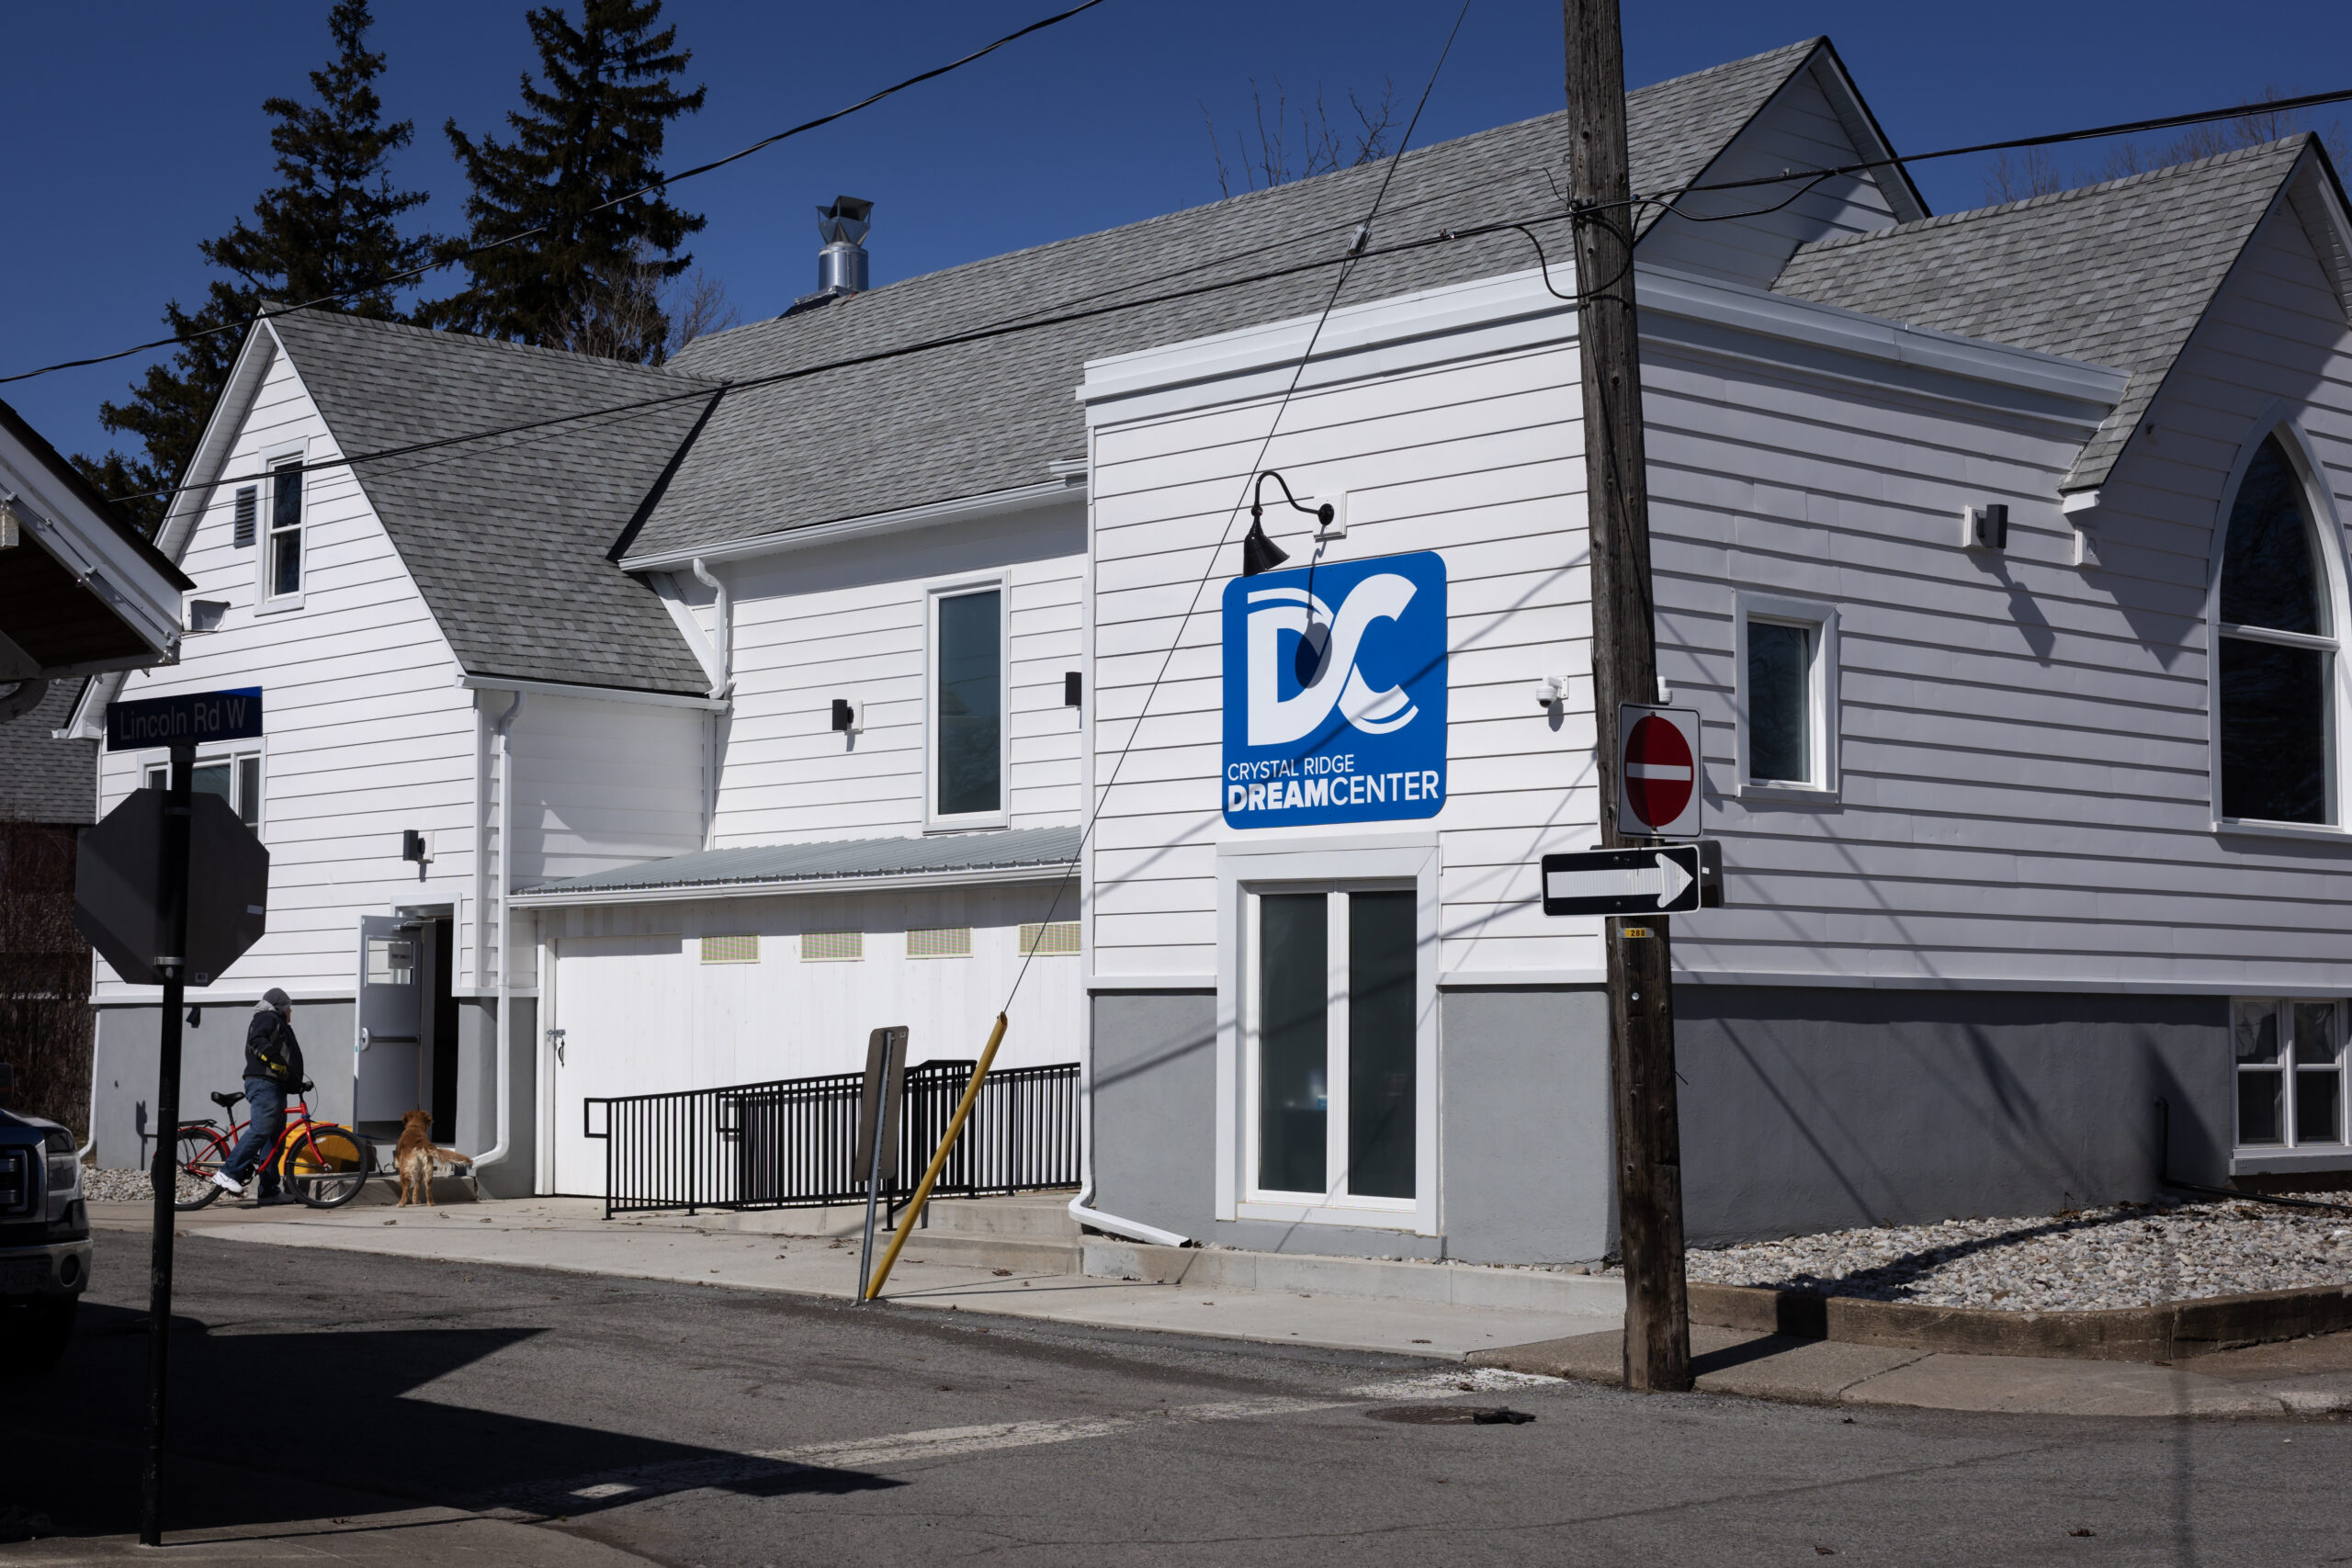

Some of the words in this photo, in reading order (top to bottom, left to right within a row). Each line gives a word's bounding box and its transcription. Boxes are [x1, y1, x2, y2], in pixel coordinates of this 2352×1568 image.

[1248, 572, 1419, 746] DC
[119, 705, 187, 741] Lincoln
[194, 700, 220, 734] Rd
[226, 697, 247, 729] W
[1227, 759, 1299, 781] CRYSTAL
[1304, 753, 1355, 775] RIDGE
[1227, 770, 1440, 813] DREAMCENTER
